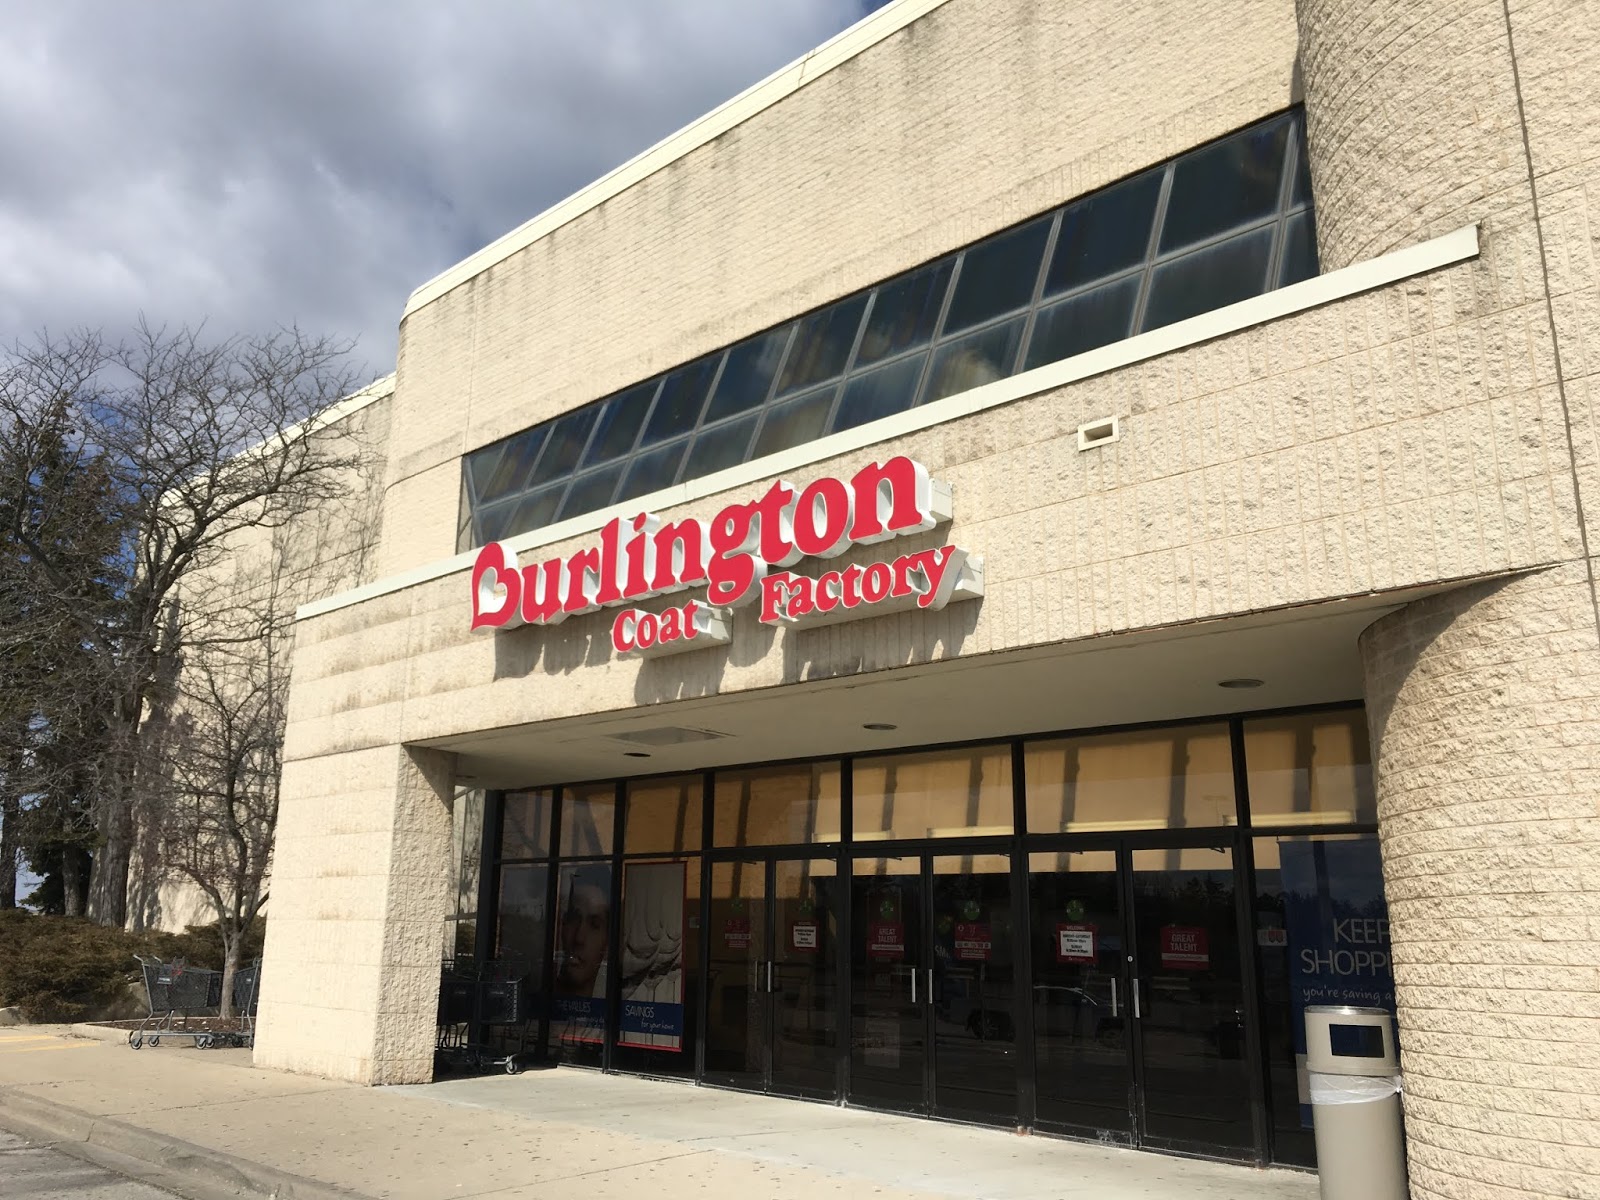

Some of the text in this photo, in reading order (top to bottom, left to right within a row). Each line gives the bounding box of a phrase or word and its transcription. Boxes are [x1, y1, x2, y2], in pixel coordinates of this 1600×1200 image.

[471, 455, 926, 632] Burlington
[612, 545, 957, 652] Coat Factory
[1170, 942, 1198, 952] TALENT
[1171, 934, 1196, 943] GREAT
[1301, 949, 1393, 977] SHOPPI
[1303, 984, 1339, 1001] you're
[1343, 987, 1381, 1006] saving
[625, 1004, 655, 1018] SAVINGS
